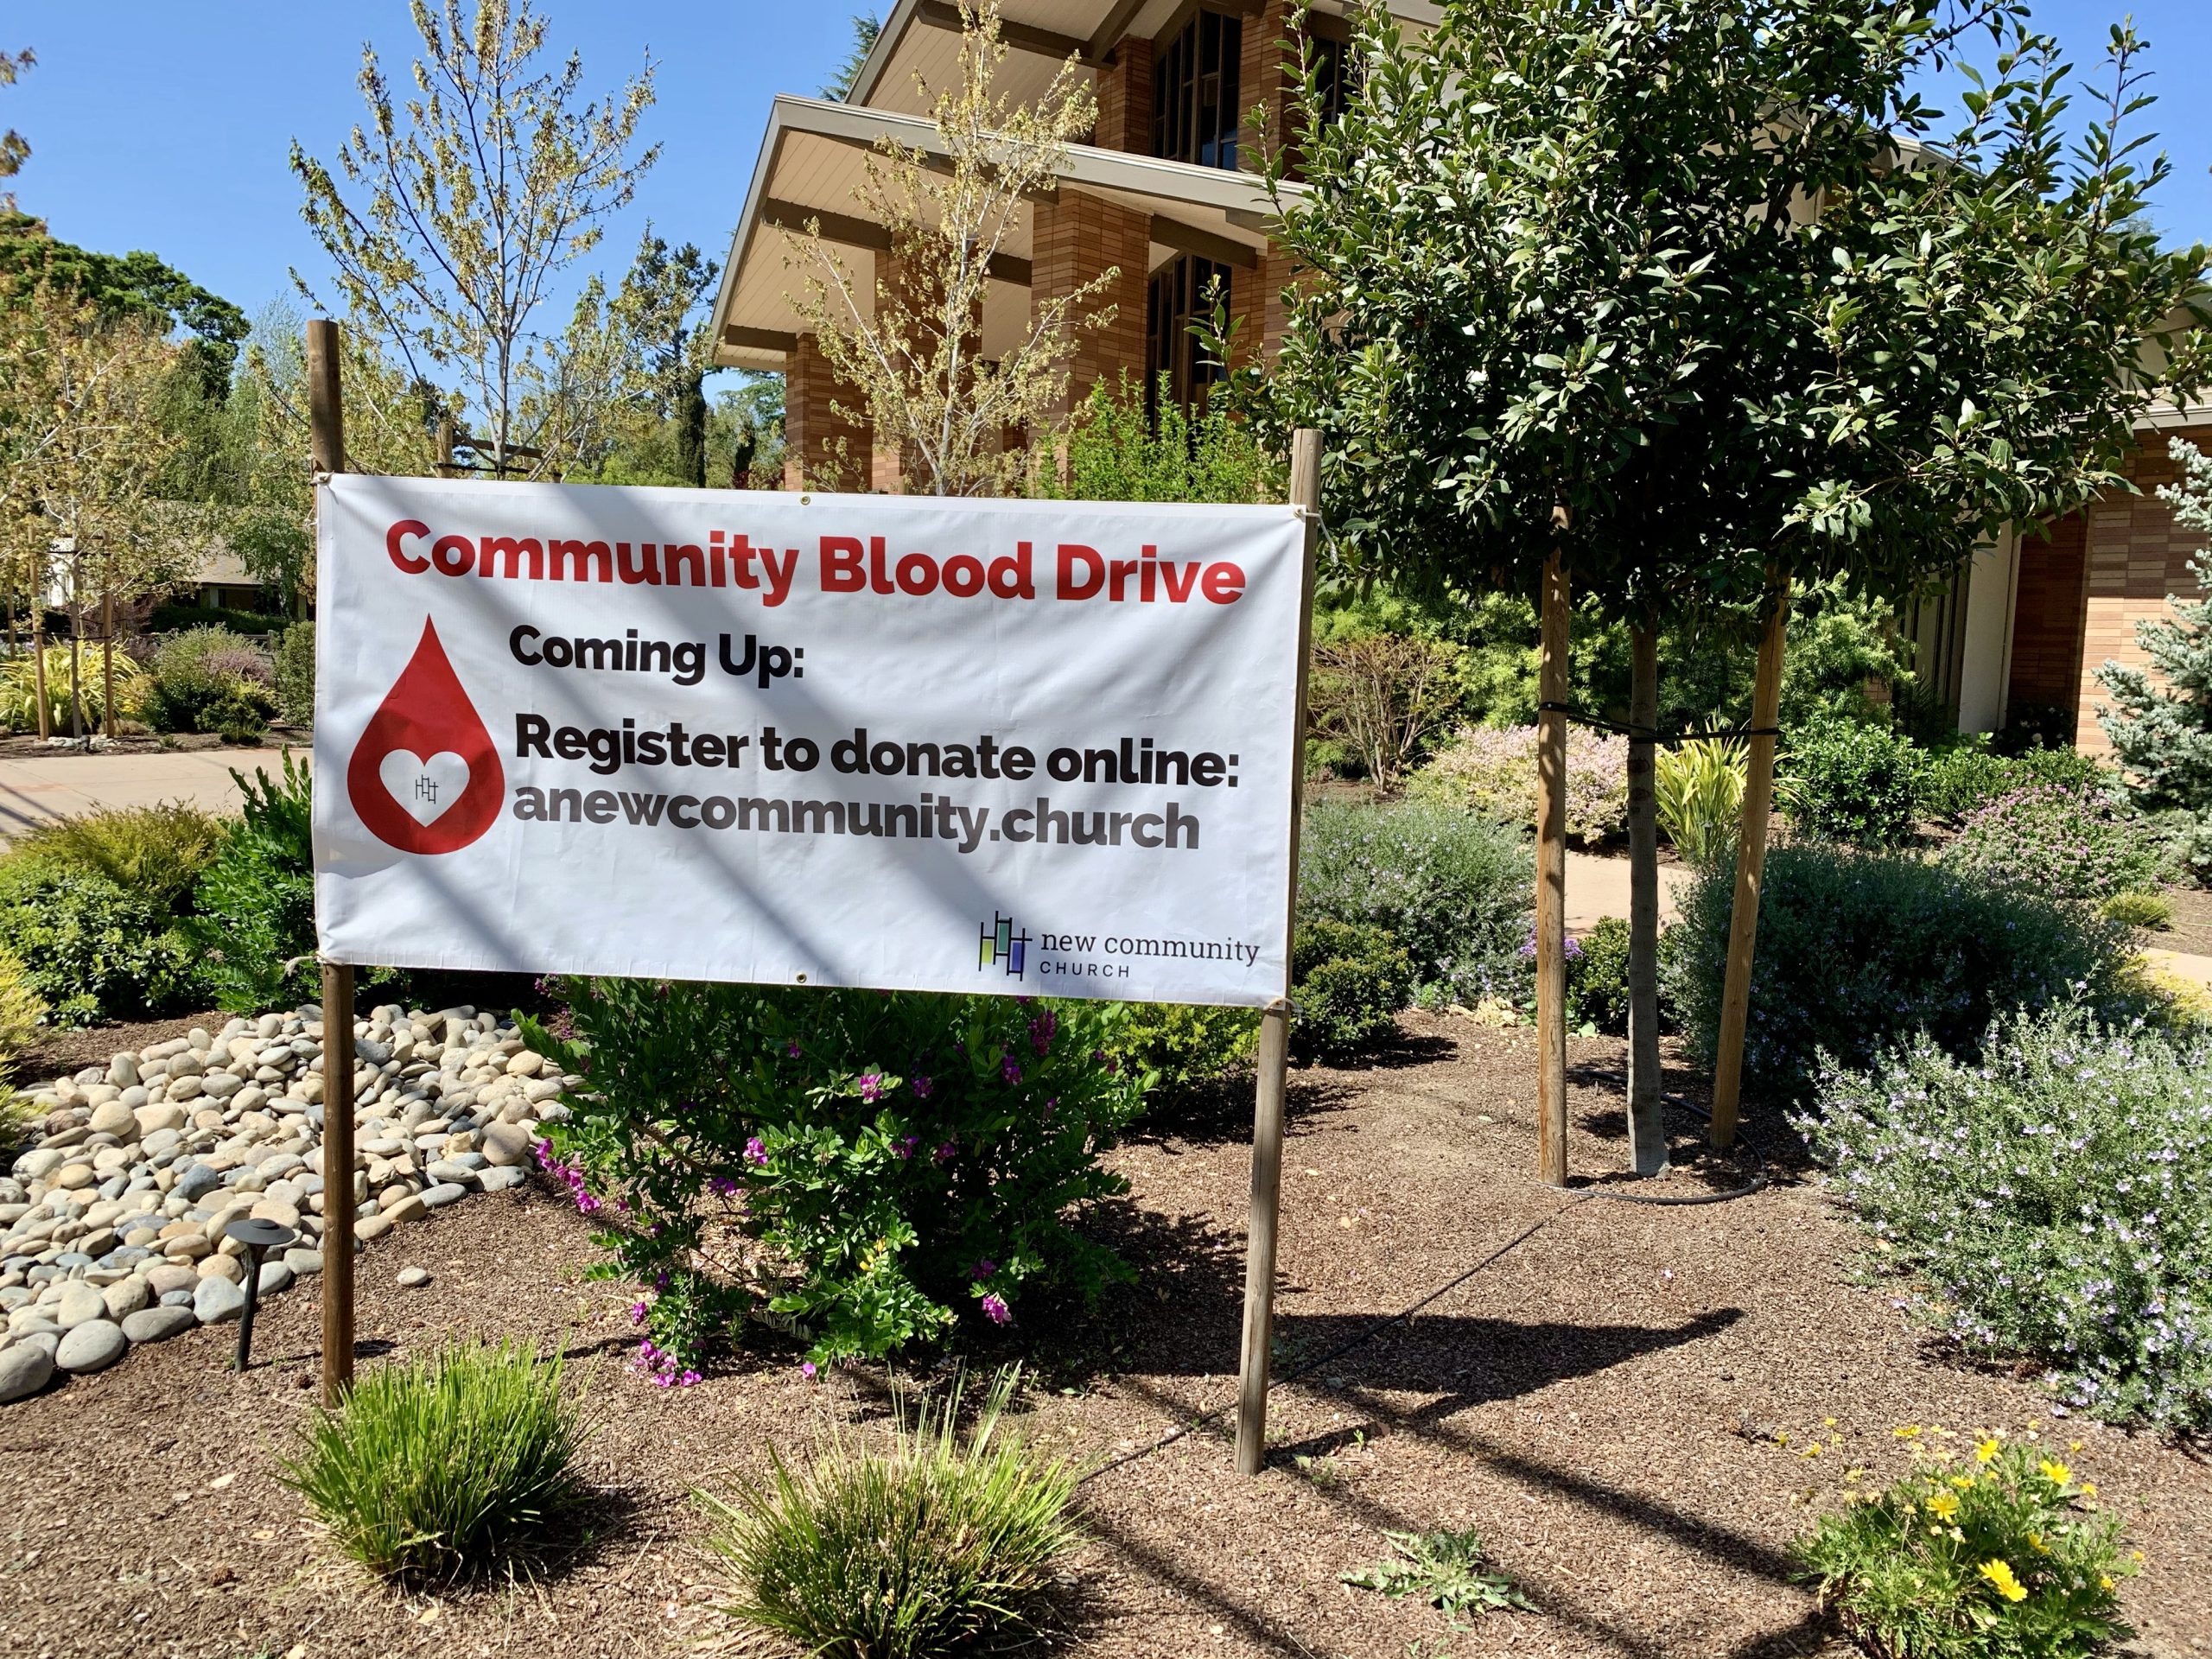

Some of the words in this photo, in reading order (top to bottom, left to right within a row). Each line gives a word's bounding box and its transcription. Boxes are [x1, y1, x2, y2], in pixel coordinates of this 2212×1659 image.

[385, 519, 800, 607] Community
[819, 536, 1036, 601] Blood
[1056, 543, 1246, 605] Drive
[509, 624, 707, 686] Coming
[718, 632, 804, 690] Up:
[515, 713, 750, 776] Register
[760, 726, 821, 772] to
[830, 727, 1036, 781] donate
[1046, 737, 1239, 788] online:
[512, 786, 1199, 854] anewcommunity.church
[1039, 960, 1130, 979] CHURCH
[1040, 932, 1097, 953] new
[1103, 936, 1261, 968] community
